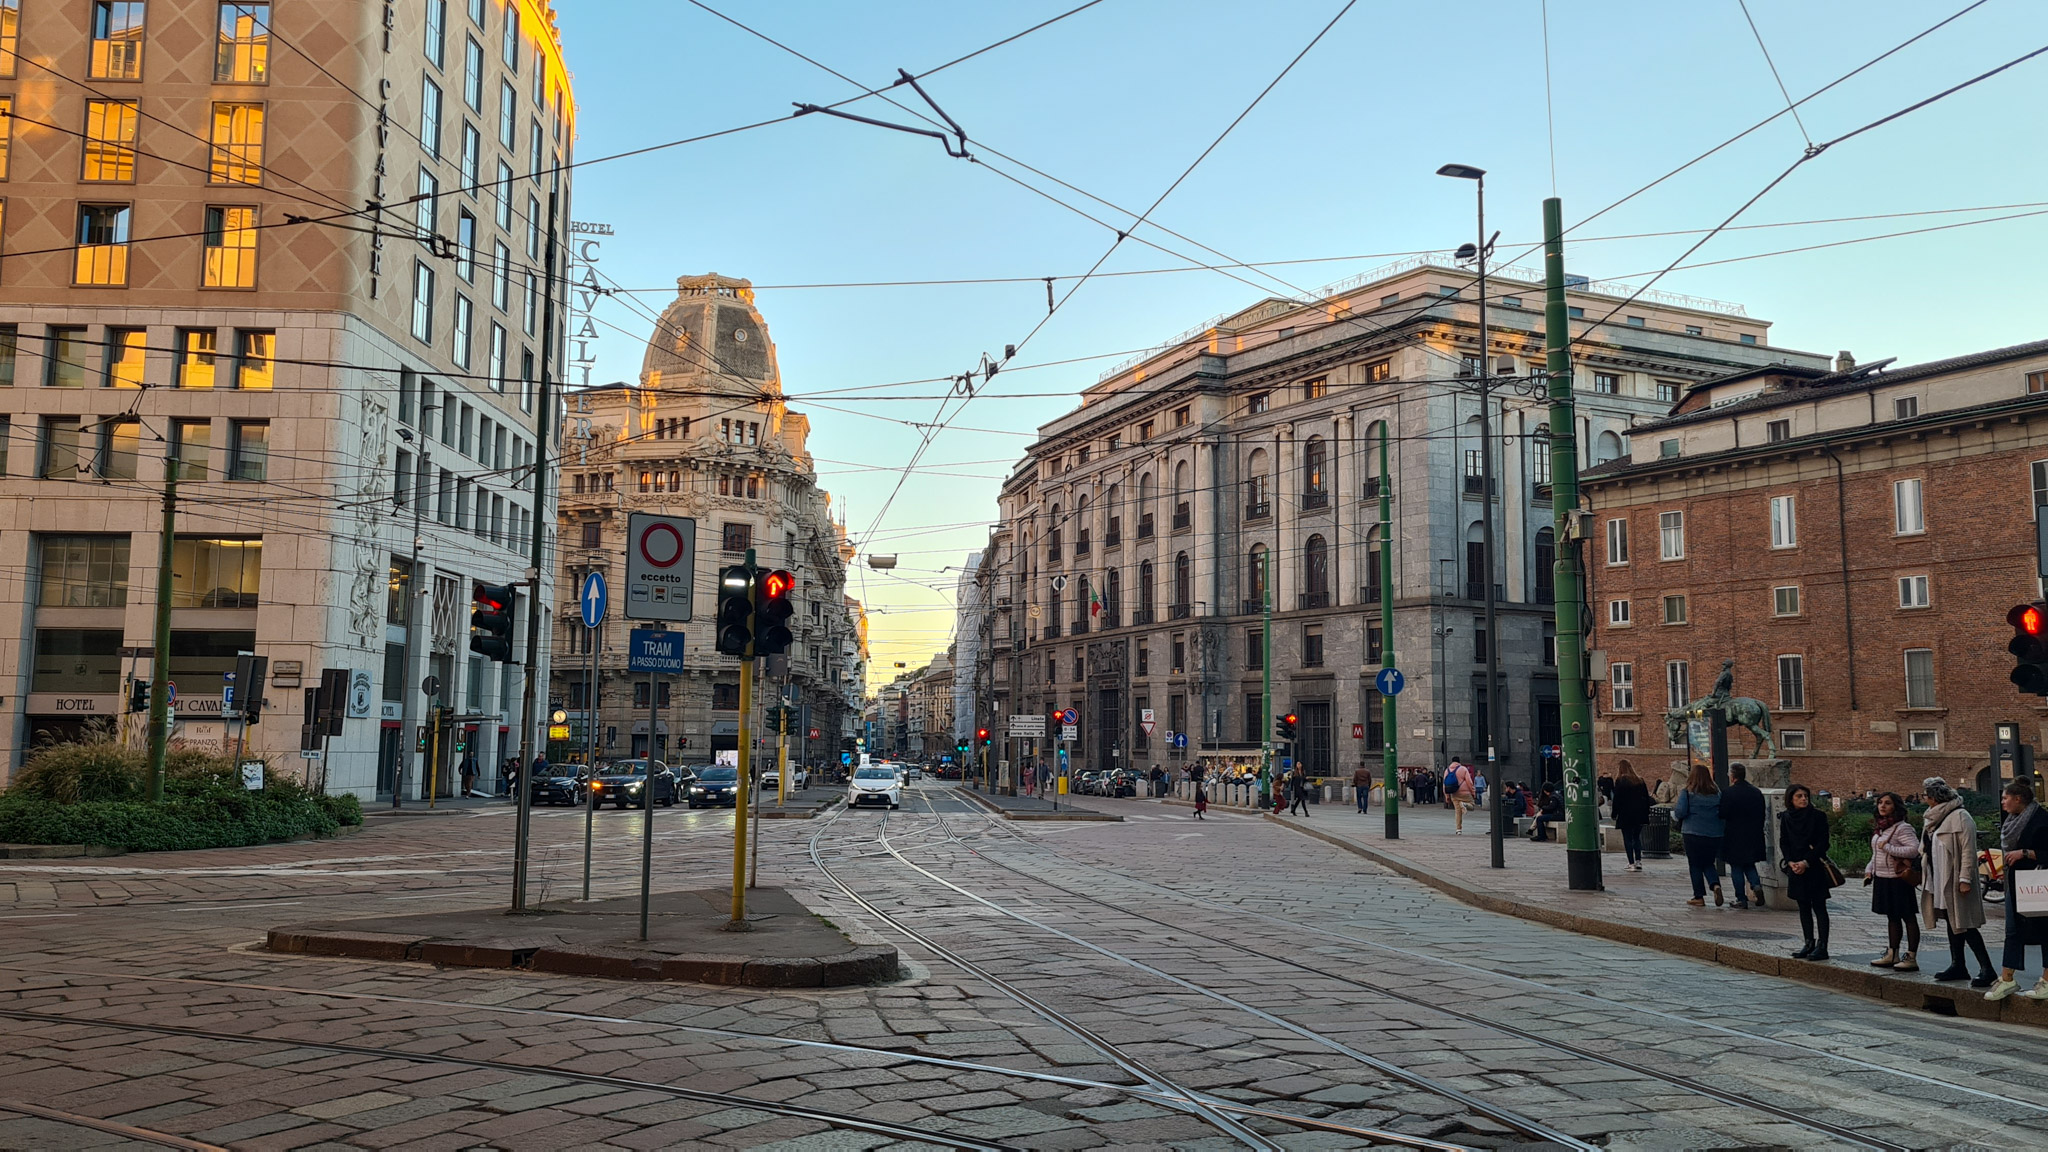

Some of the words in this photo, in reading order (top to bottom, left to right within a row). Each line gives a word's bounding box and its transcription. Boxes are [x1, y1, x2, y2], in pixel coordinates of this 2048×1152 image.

[571, 221, 614, 233] HOTEL
[576, 241, 601, 465] CAVALIERI
[641, 573, 681, 583] eccetto
[642, 640, 672, 657] TRAM
[631, 656, 637, 667] A
[637, 656, 657, 668] PASSO
[657, 657, 681, 669] D'UOMO
[56, 699, 95, 711] HOTEL
[551, 697, 563, 705] BAR
[189, 738, 218, 746] PRANZO
